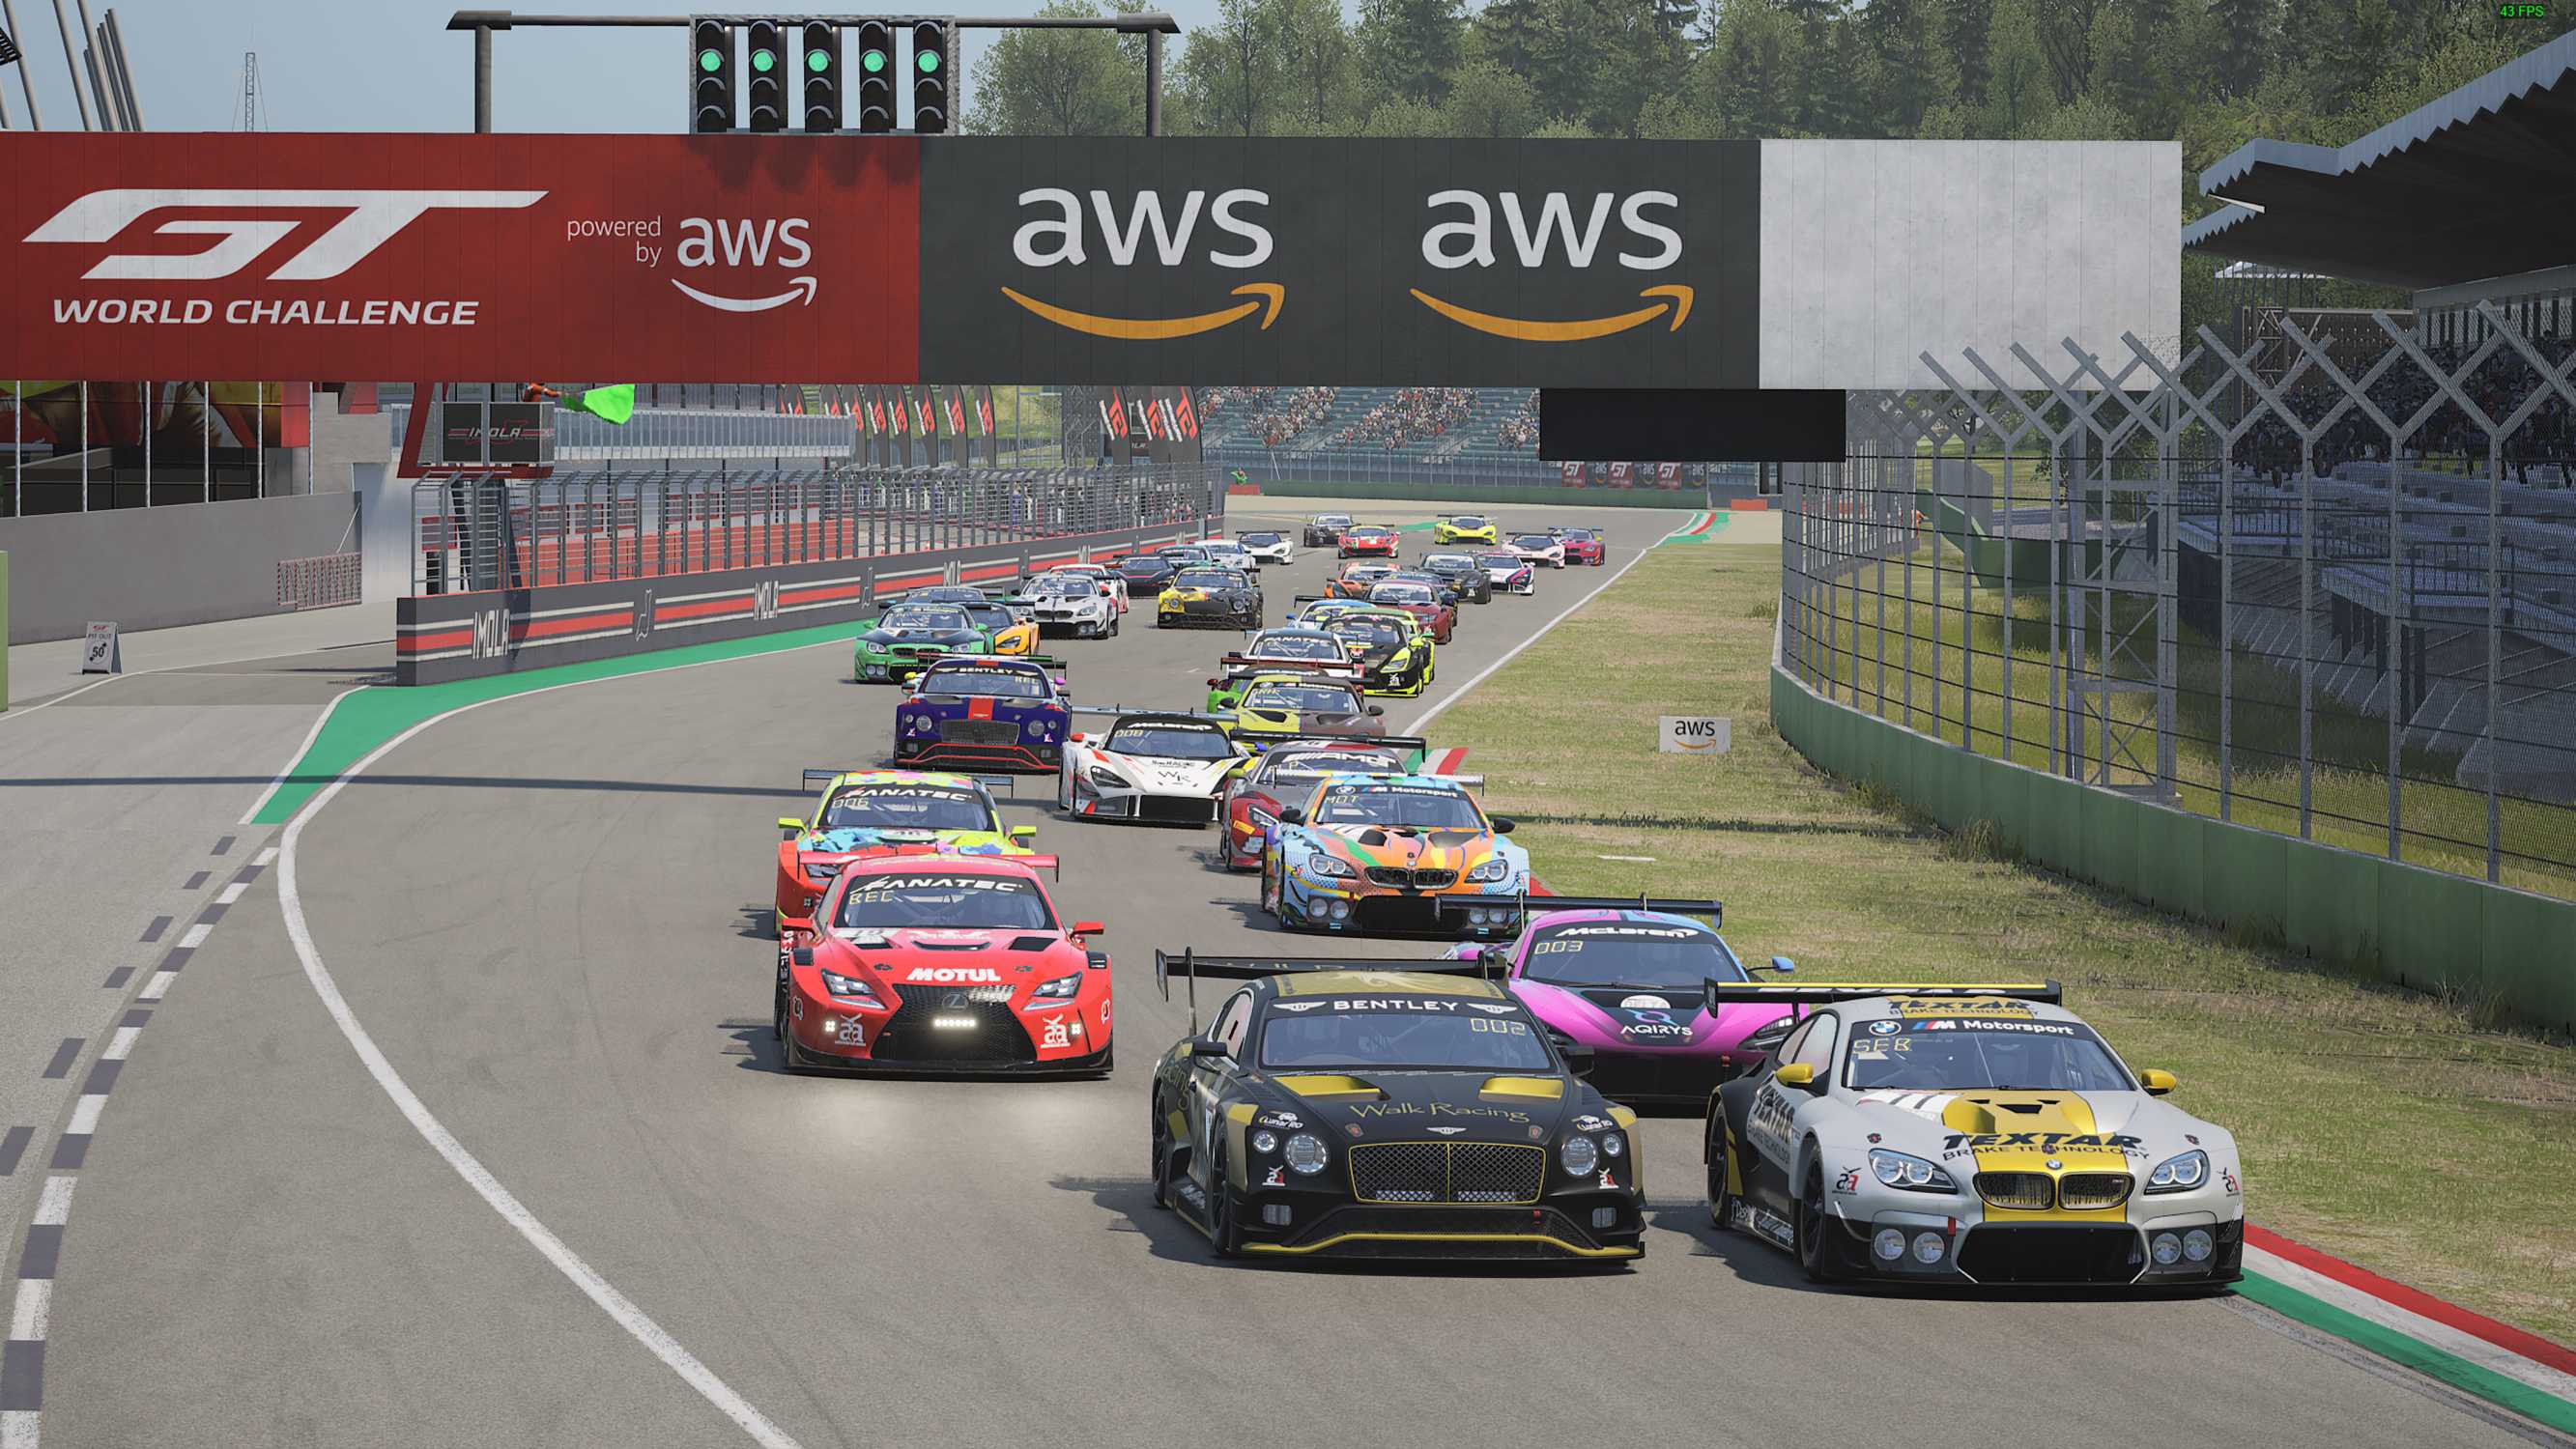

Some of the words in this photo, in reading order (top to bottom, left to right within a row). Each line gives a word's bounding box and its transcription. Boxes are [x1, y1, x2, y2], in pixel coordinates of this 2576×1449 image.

[21, 189, 549, 280] GT
[567, 215, 661, 241] powered
[1013, 187, 1274, 269] aws
[1421, 189, 1684, 270] aws
[677, 217, 812, 268] aws
[636, 241, 662, 268] by
[52, 299, 213, 324] WORLD
[225, 300, 479, 325] CHALLENGE
[472, 609, 510, 660] IMOLA
[92, 646, 104, 658] 50
[1674, 720, 1715, 737] aws
[835, 785, 972, 802] FANATEC
[1392, 785, 1458, 798] Motorsport
[850, 875, 1022, 893] FANATEC
[1555, 926, 1699, 939] McLaren
[1534, 940, 1583, 954] 003
[906, 967, 1002, 981] MOTUL
[1333, 1000, 1458, 1011] BENTLEY
[1470, 1017, 1527, 1036] 002
[1620, 1024, 1693, 1037] AQIRYS
[1963, 1020, 2075, 1036] Motorsport
[1350, 1102, 1425, 1118] Walk
[1430, 1102, 1530, 1122] Racing
[1943, 1132, 2142, 1151] TEXTAR
[1942, 1146, 2010, 1161] BRAKE
[2019, 1145, 2149, 1159] TEHNOLOGY
